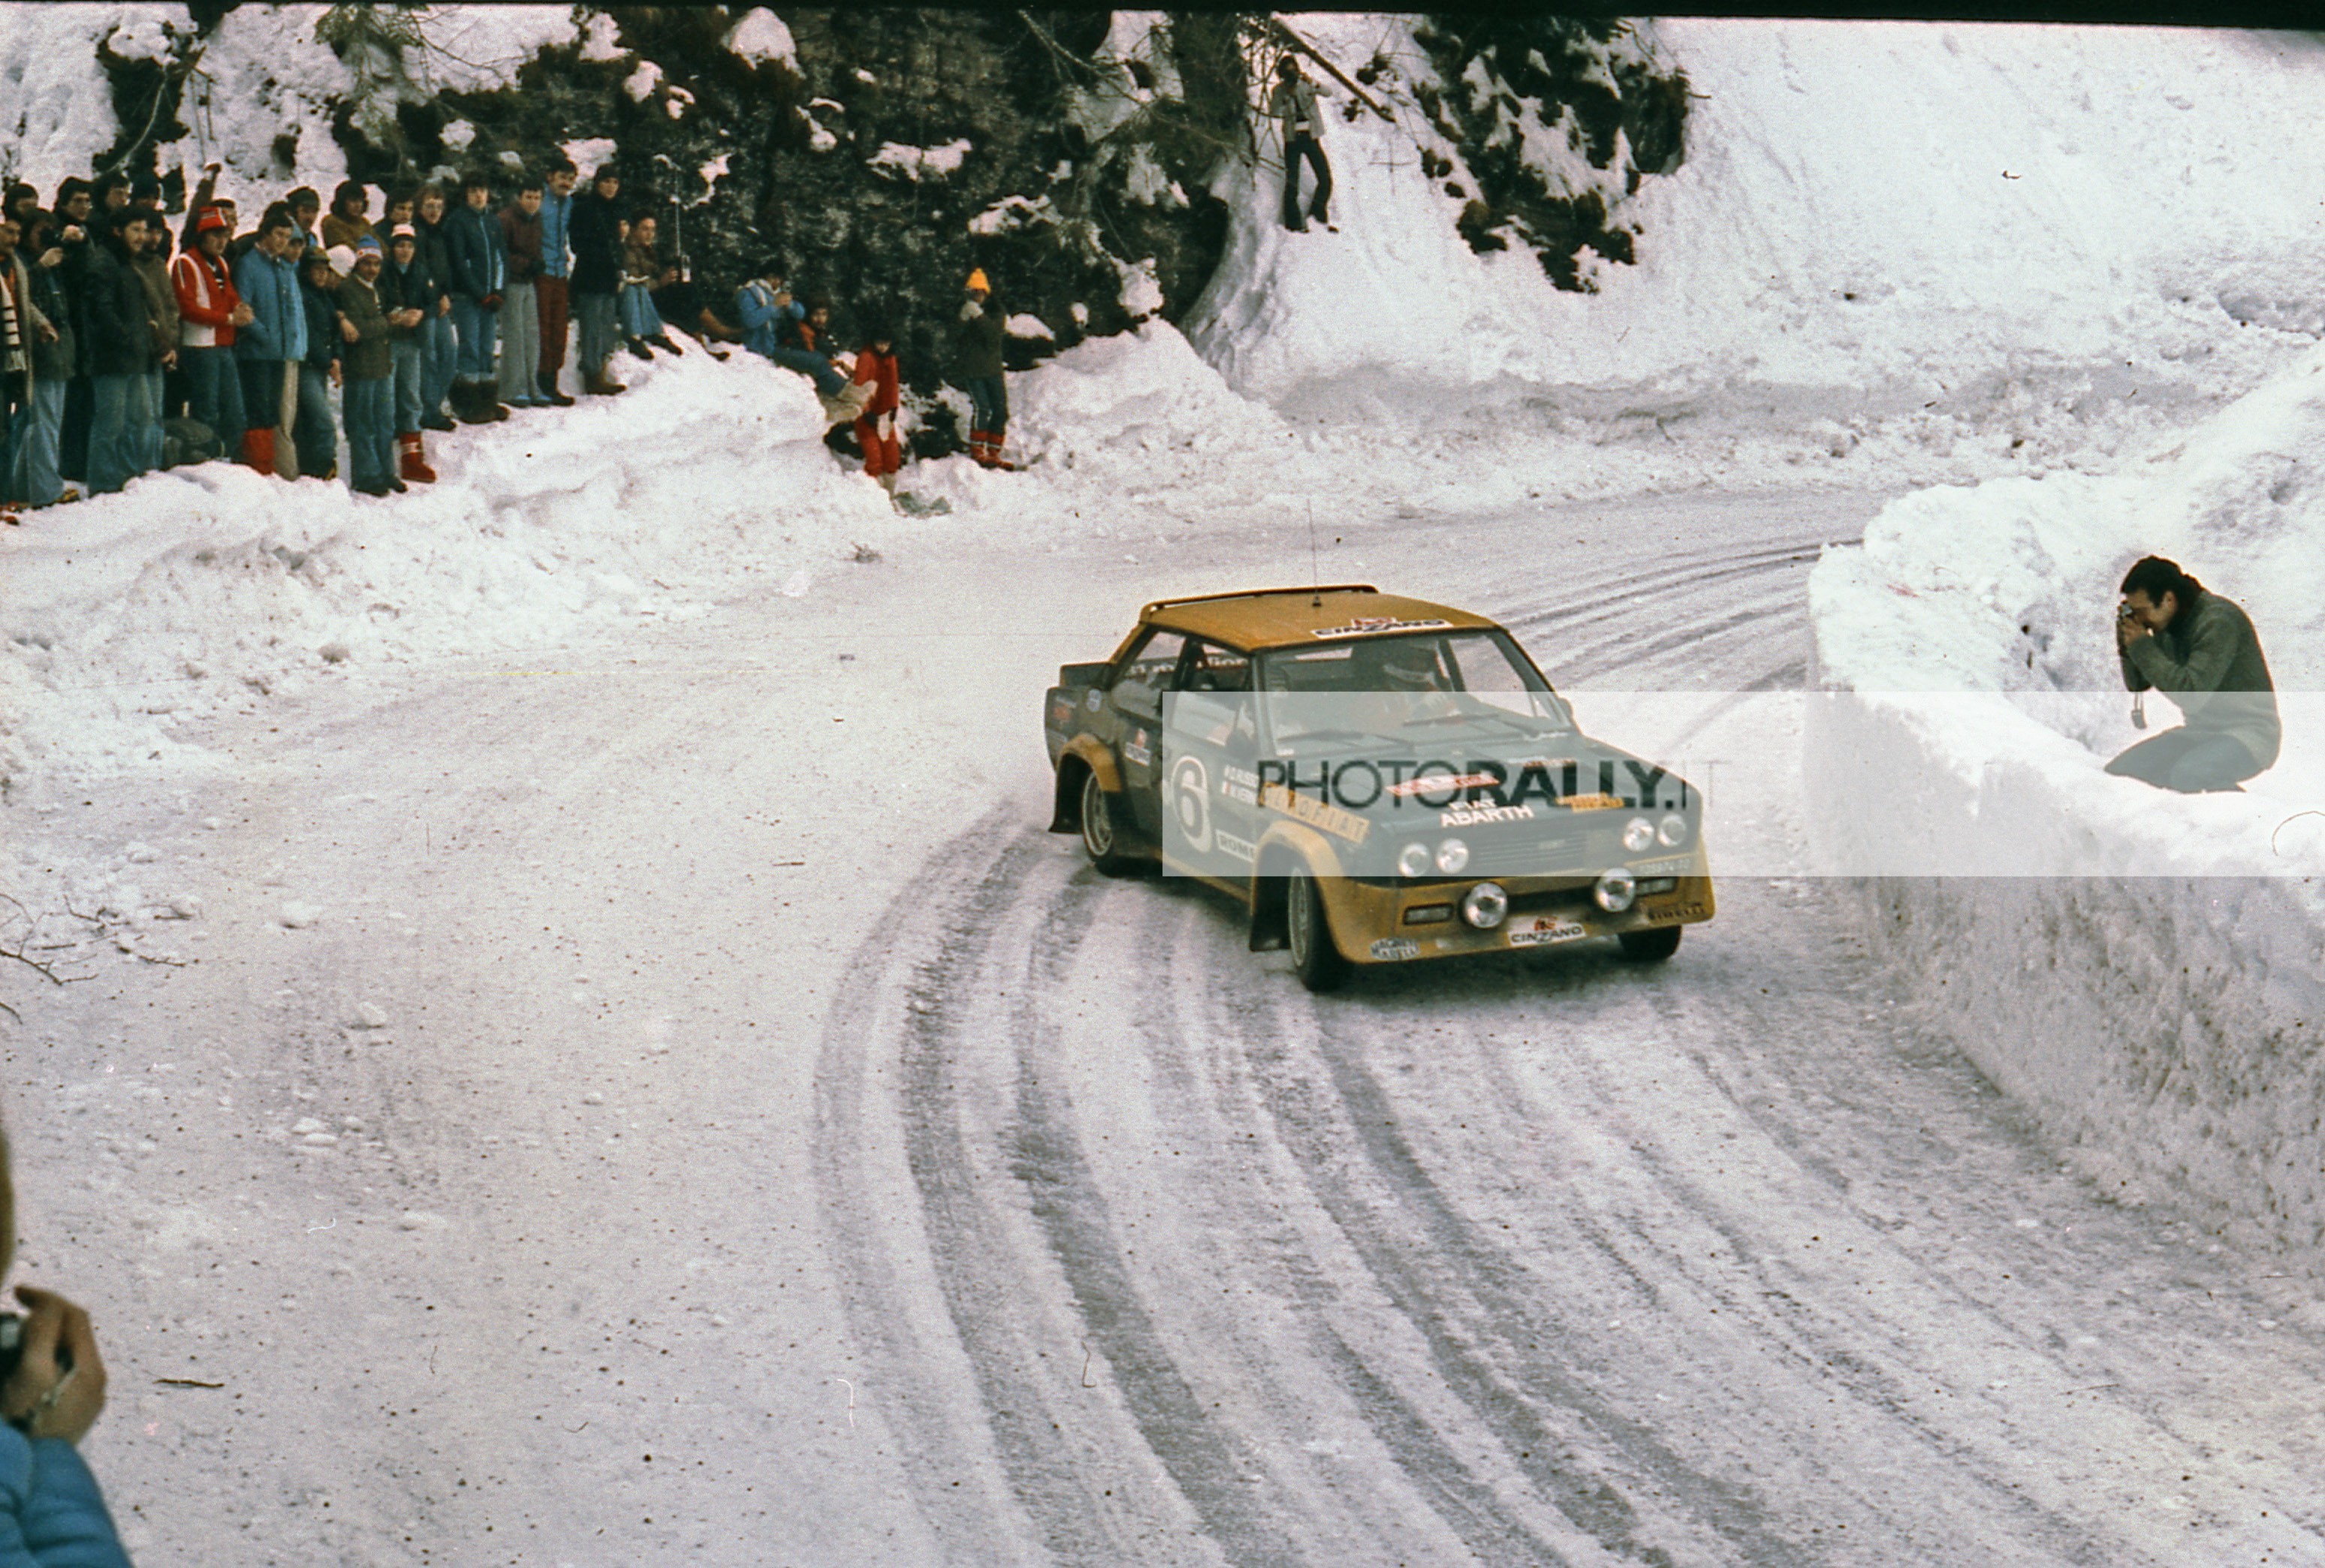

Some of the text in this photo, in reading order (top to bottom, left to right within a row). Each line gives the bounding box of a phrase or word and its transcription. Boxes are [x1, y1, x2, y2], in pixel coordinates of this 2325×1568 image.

[1172, 758, 1206, 843] 6
[1440, 804, 1534, 828] ABARTH
[1511, 924, 1583, 944] CINZANO
